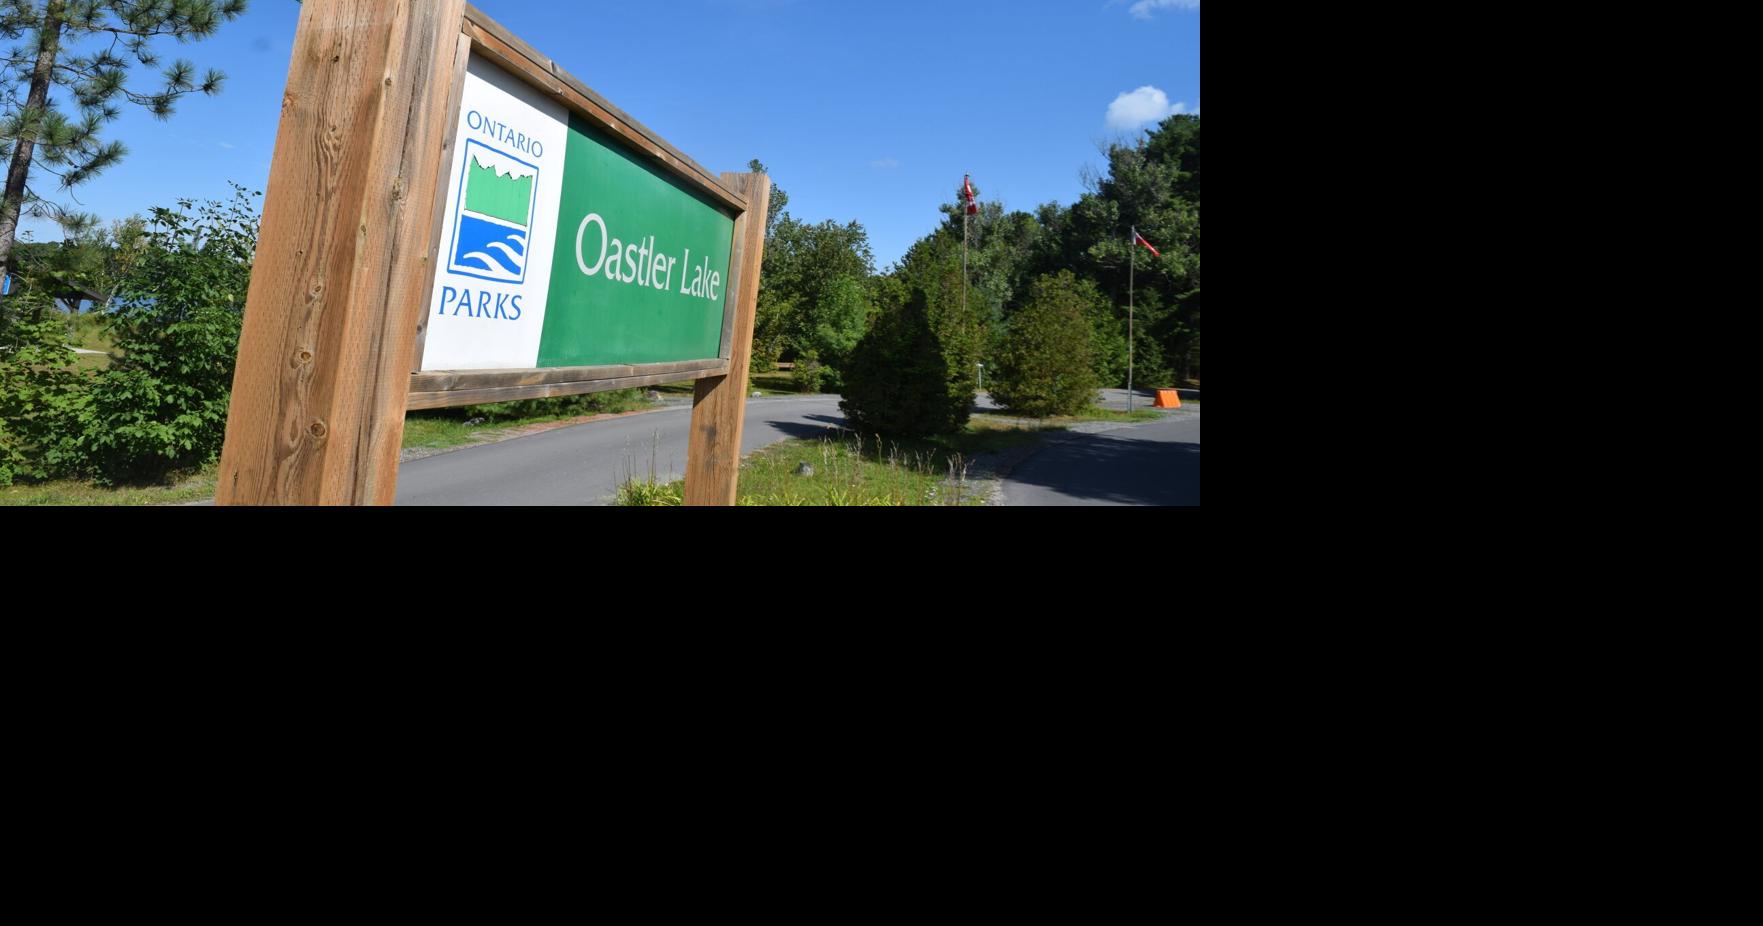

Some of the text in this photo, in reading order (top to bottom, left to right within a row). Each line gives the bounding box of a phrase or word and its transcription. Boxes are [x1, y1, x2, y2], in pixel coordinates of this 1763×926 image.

[467, 110, 544, 158] ONTARIO
[576, 213, 721, 301] Oastler Lake
[438, 285, 522, 321] PARKS
